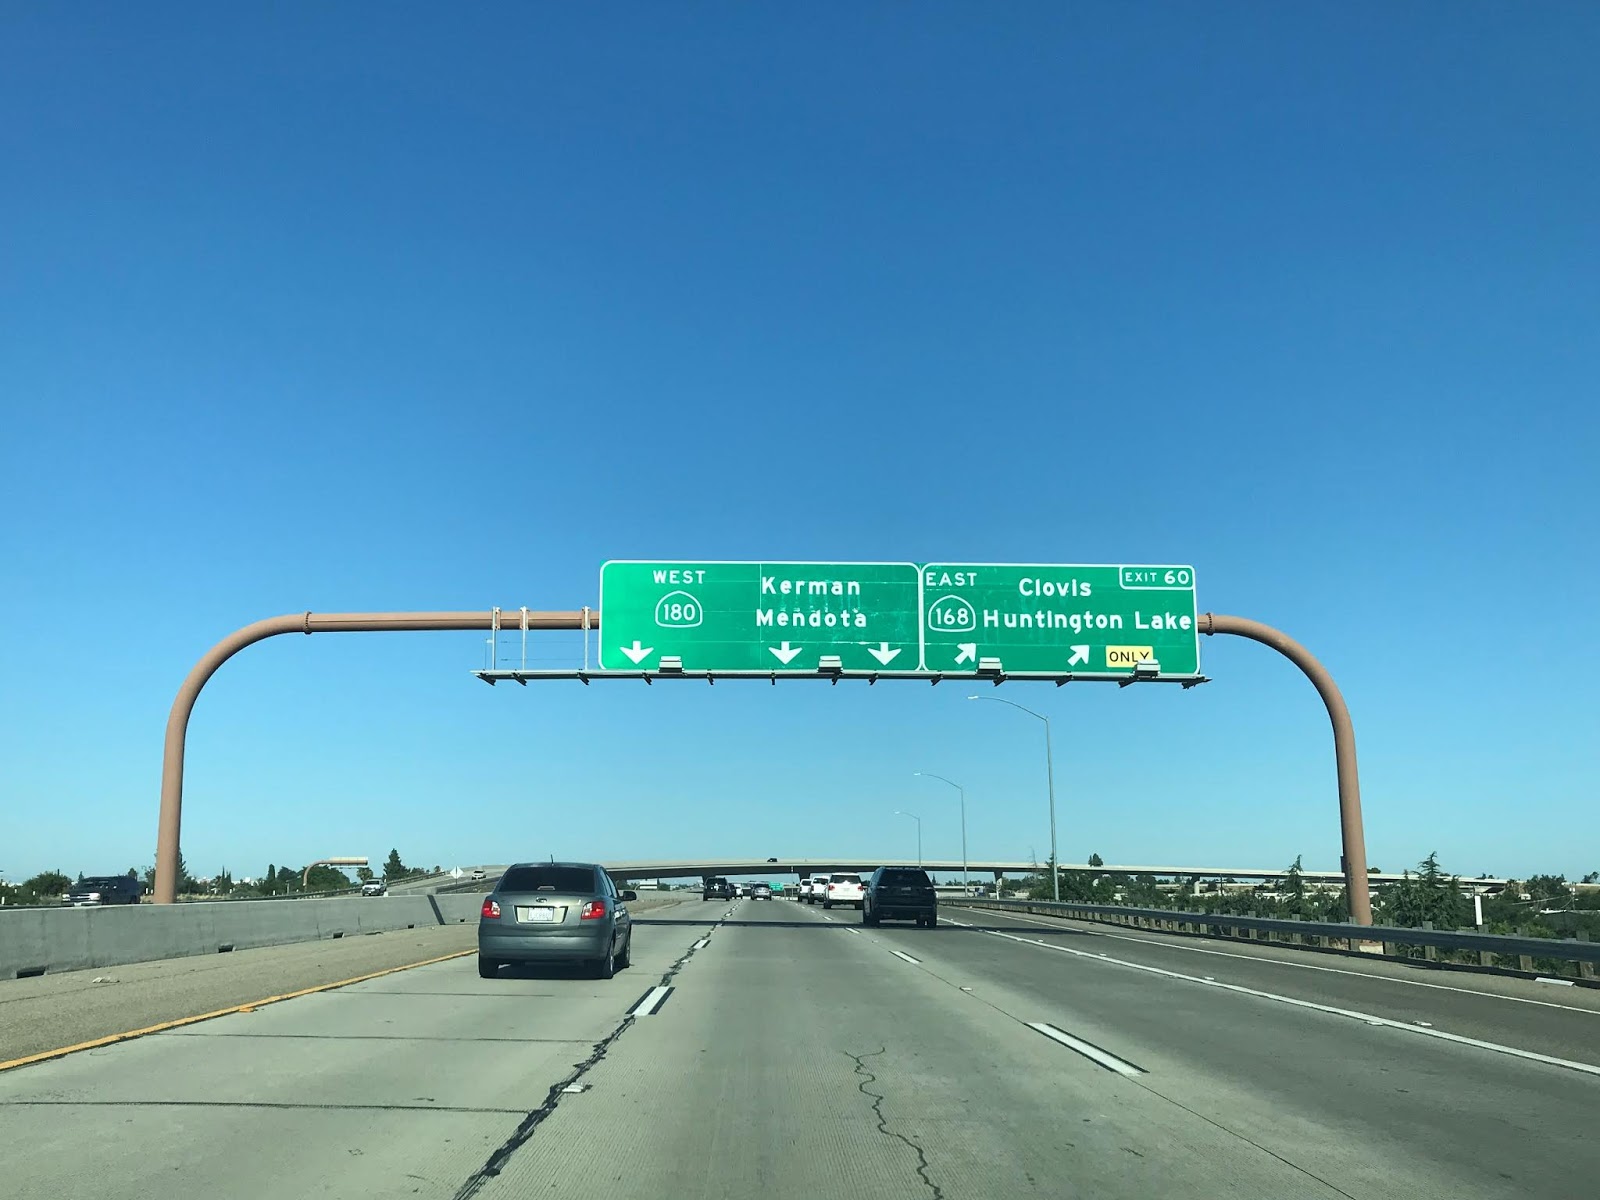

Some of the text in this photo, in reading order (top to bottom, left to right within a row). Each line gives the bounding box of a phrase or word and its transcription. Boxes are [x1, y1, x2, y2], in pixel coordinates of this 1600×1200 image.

[653, 570, 706, 584] WEST
[762, 576, 860, 595] Kerman
[926, 572, 977, 587] EAST
[1125, 570, 1190, 584] EXIT 60
[1019, 578, 1092, 597] Clovis
[663, 603, 696, 621] 180
[756, 609, 867, 627] Mendota
[935, 608, 969, 625] 168
[983, 610, 1192, 634] Huntington Lake
[1109, 651, 1150, 663] ONLY
